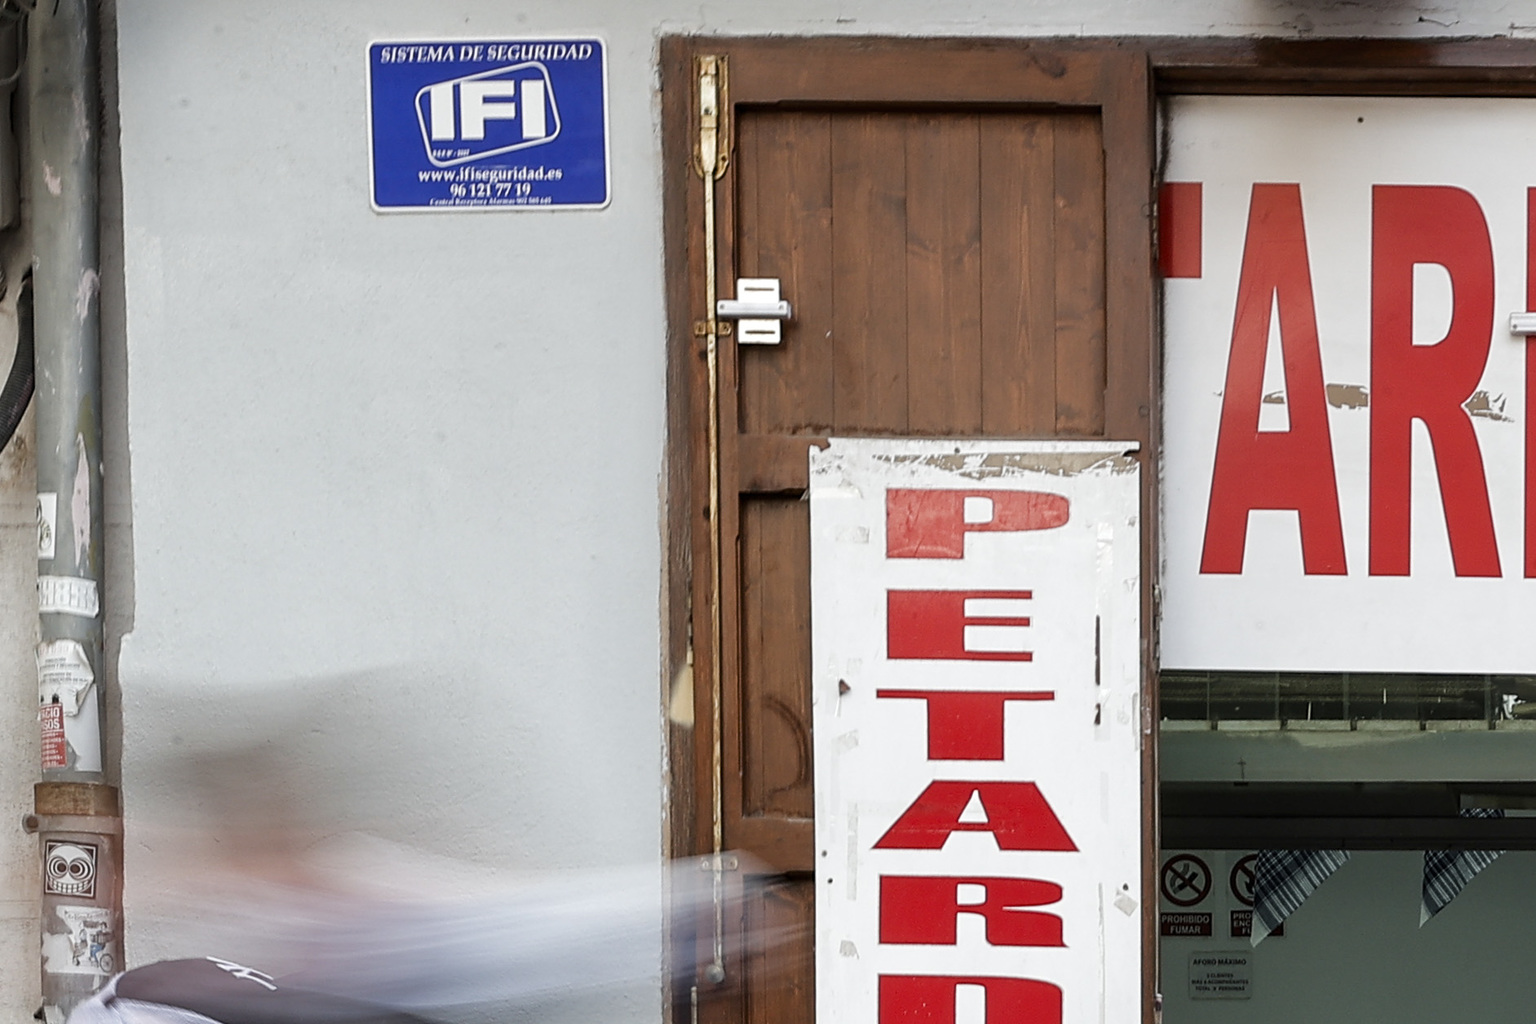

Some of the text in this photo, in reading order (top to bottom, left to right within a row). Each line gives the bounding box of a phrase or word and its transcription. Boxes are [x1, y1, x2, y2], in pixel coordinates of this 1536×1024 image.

[381, 43, 593, 63] SISTEMA DE SEGURIDAD
[430, 79, 547, 141] IFI
[418, 165, 563, 184] www.ifiseguridad.es
[449, 182, 532, 197] 96 121 77 19
[1161, 914, 1210, 923] PROHIBIDO
[1170, 925, 1201, 934] FUMAR
